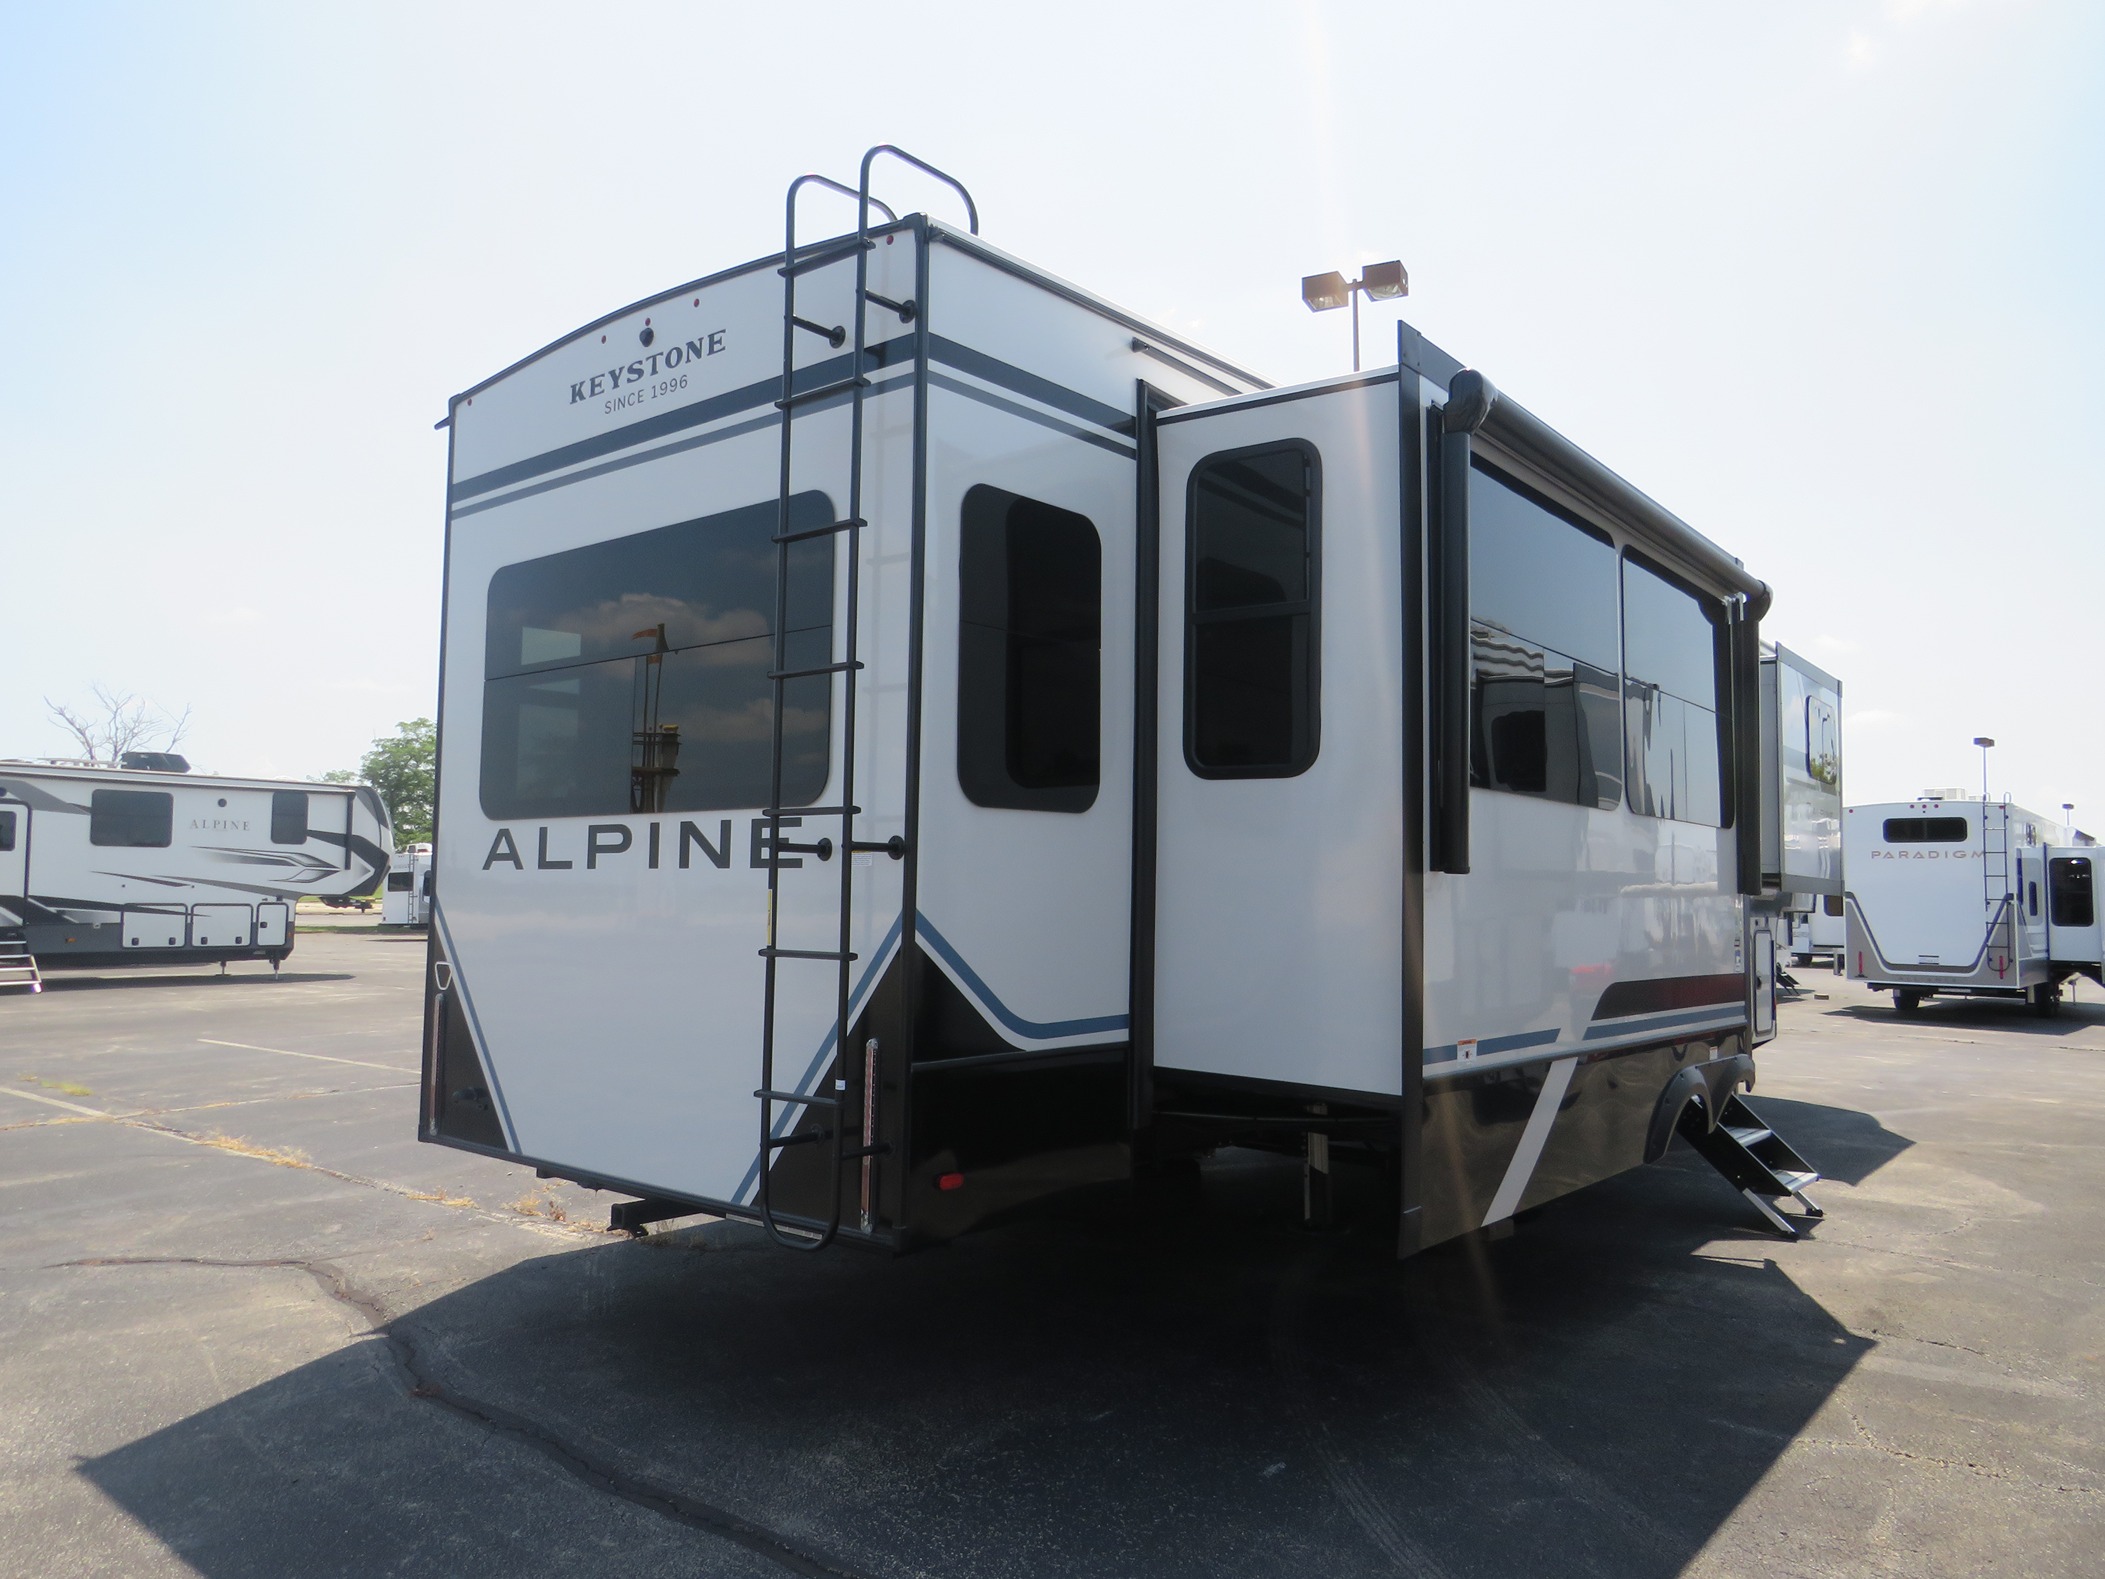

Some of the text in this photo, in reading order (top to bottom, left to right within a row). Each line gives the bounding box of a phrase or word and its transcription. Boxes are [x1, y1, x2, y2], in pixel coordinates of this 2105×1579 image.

[569, 329, 727, 405] KEYSTONE
[604, 374, 688, 414] SINCE 1996
[189, 819, 250, 831] ALPINE
[482, 817, 804, 871] ALPINE
[1871, 850, 1985, 859] PARADIGM
